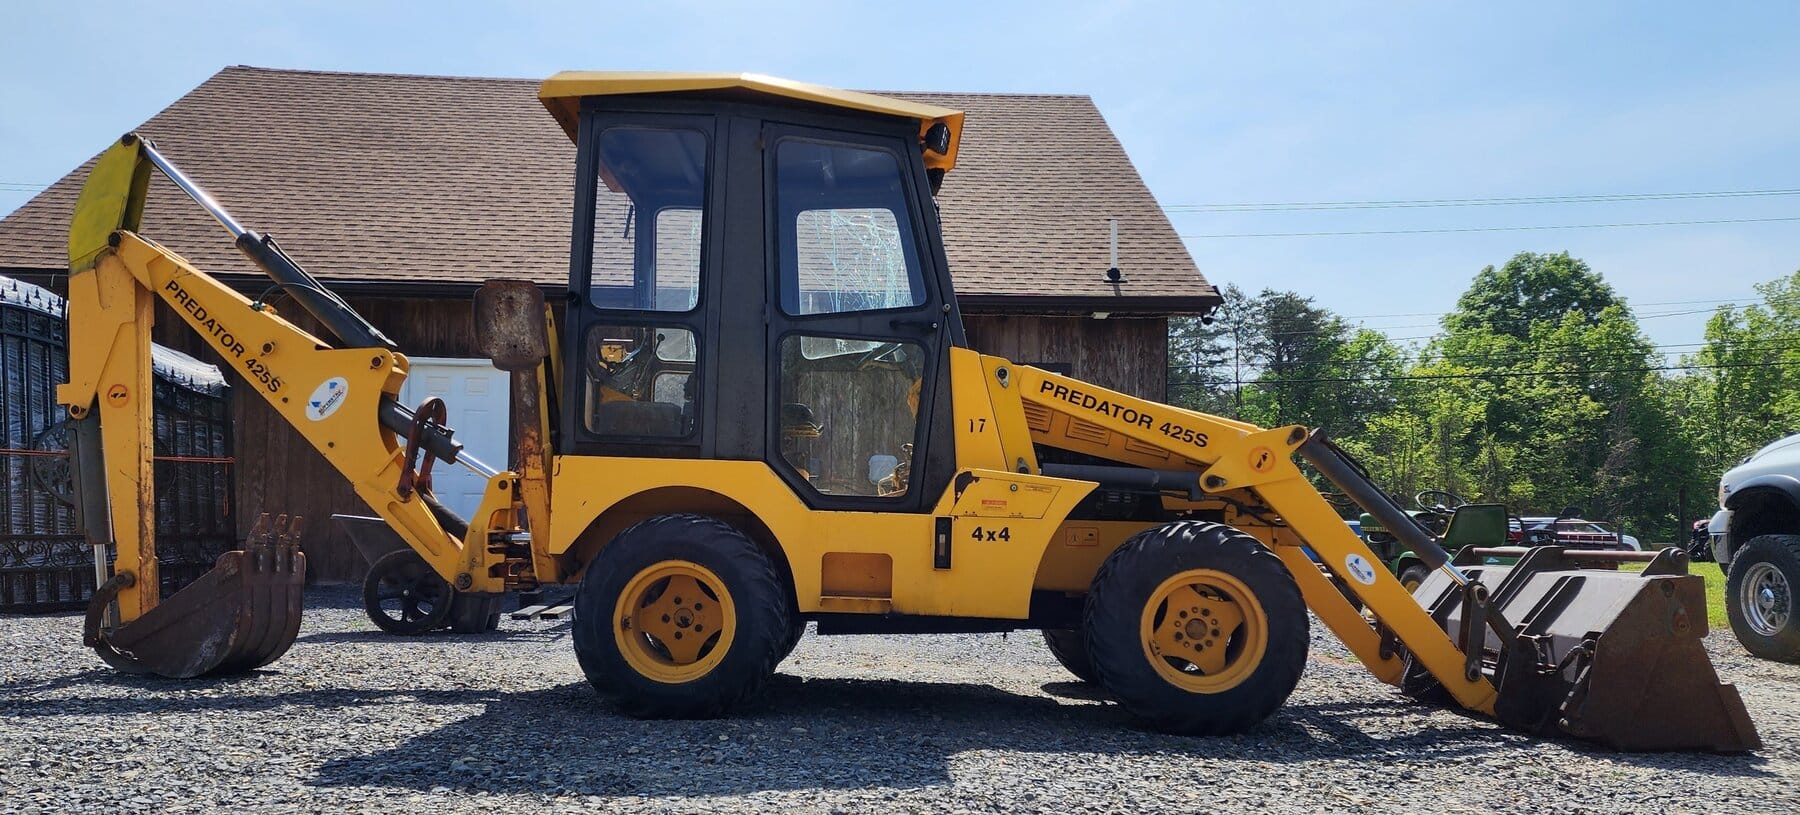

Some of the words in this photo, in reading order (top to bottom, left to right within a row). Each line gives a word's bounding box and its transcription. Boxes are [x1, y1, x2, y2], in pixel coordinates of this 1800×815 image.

[165, 280, 245, 358] PREDATOR
[245, 358, 280, 393] 425S
[1040, 380, 1153, 429] PREDATOR
[1159, 422, 1208, 448] 425S
[971, 526, 1011, 542] 4x4
